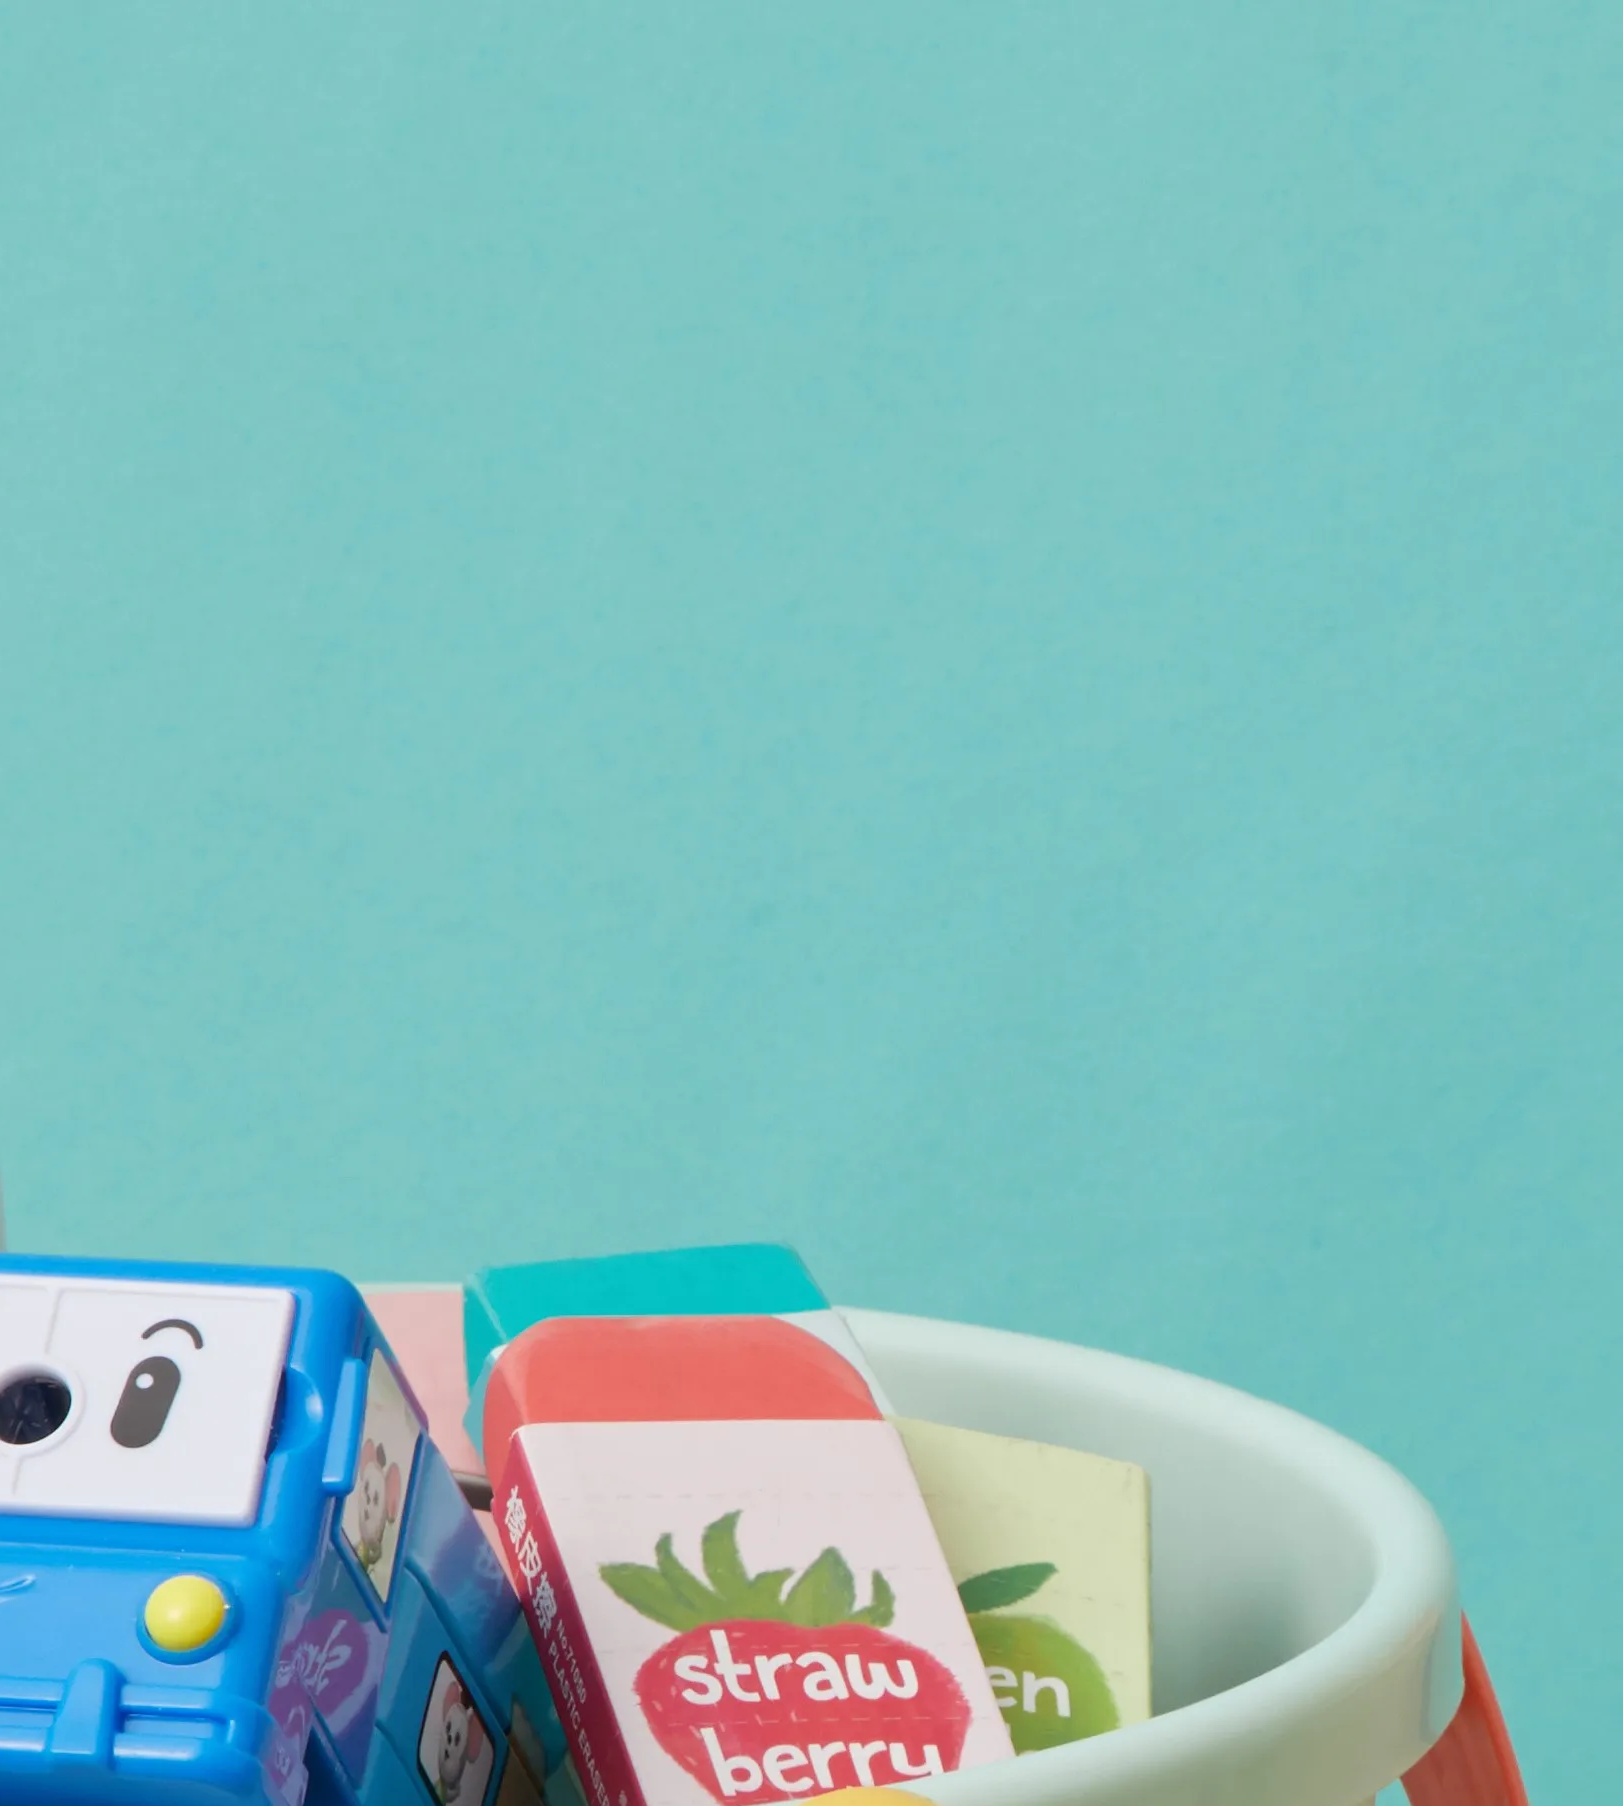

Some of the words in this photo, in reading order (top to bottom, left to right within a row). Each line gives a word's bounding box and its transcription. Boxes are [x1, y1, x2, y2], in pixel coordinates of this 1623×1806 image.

[548, 1640, 581, 1730] PLASTIC
[675, 1630, 919, 1706] straw
[701, 1728, 944, 1796] berry
